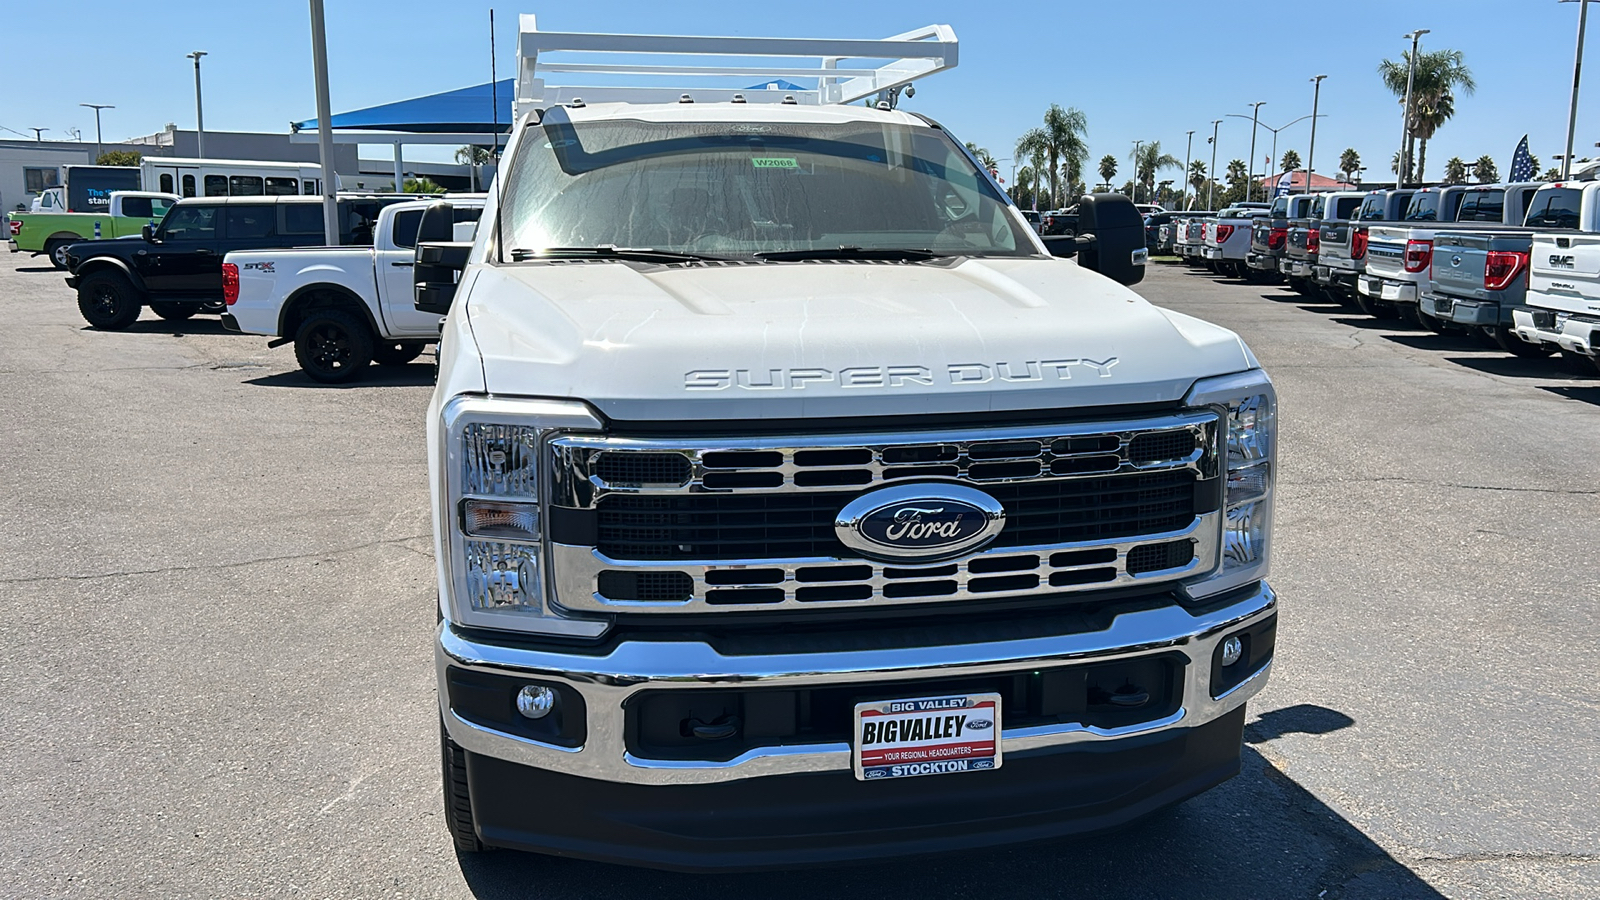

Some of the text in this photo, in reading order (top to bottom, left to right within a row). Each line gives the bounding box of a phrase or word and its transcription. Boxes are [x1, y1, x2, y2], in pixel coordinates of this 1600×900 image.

[755, 159, 794, 167] W2068
[87, 188, 104, 197] The
[243, 261, 275, 270] STX
[1548, 254, 1575, 266] GMC
[683, 356, 1121, 391] SUPER DUTY
[885, 507, 964, 541] Ford
[891, 698, 966, 712] BIG VALLEY
[862, 714, 968, 745] BIGVALLEY
[884, 746, 972, 761] YOUR REGIONAL HEADQUARTERS
[891, 760, 969, 777] STOCKTON
